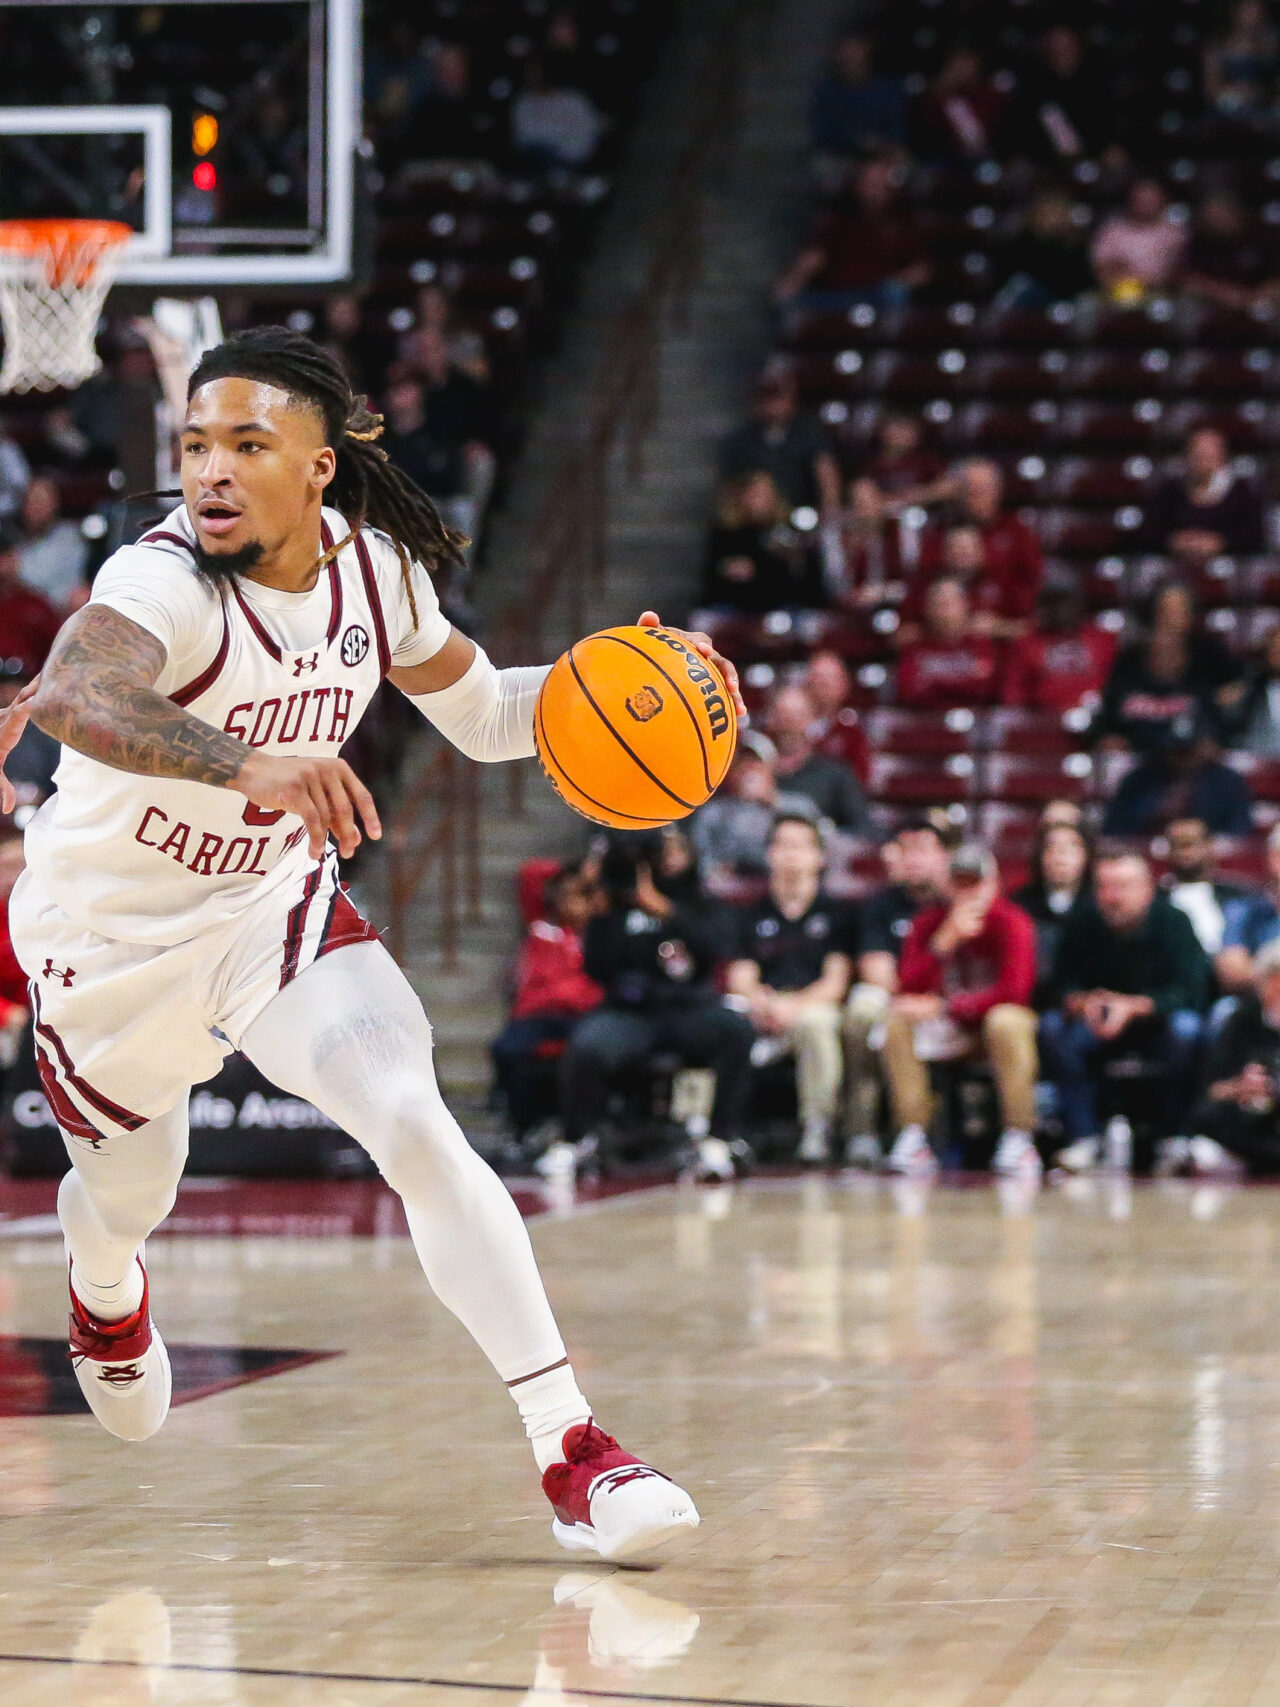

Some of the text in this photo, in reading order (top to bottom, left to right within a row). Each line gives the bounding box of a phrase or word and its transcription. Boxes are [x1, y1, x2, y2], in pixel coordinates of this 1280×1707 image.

[341, 626, 369, 666] SEC
[222, 686, 354, 748] SOUTH
[134, 805, 308, 876] CAROL
